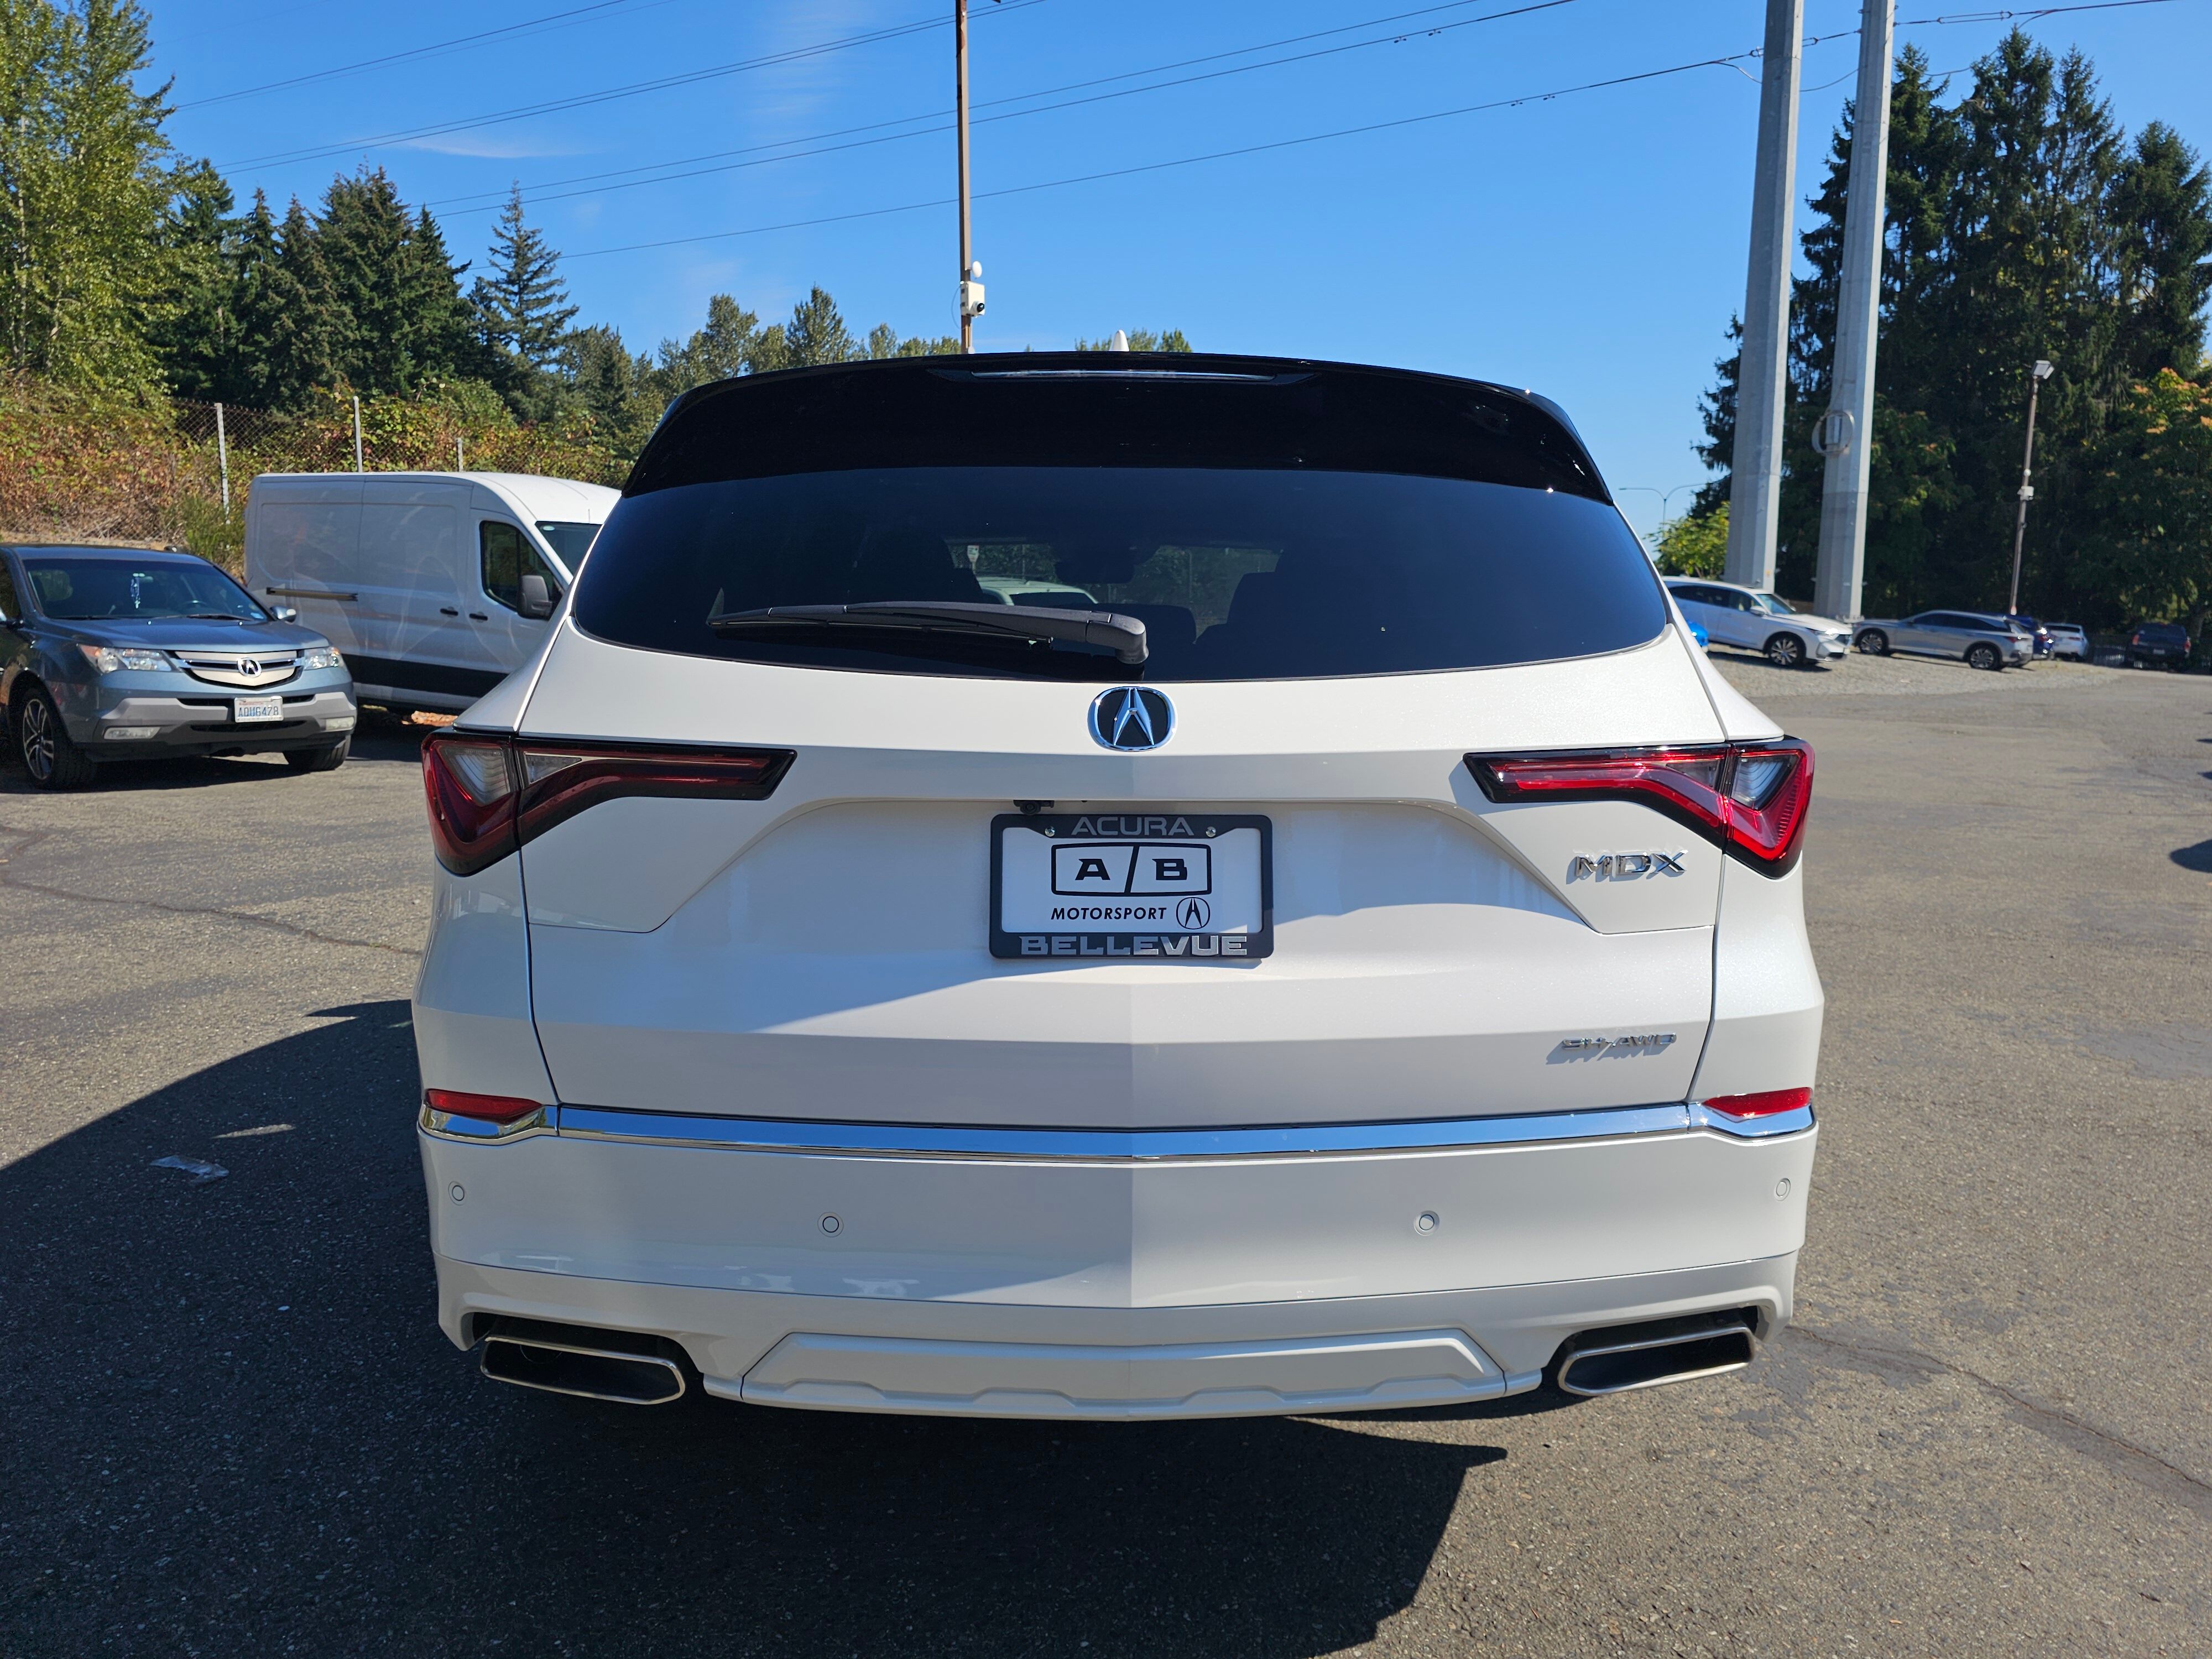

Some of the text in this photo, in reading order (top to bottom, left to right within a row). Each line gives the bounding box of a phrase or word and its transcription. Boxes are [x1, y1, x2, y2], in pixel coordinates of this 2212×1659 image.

[1071, 817, 1194, 836] ACURA
[1575, 852, 1688, 877] MDX
[1051, 907, 1167, 920] MOTORSPORT
[1019, 935, 1248, 956] BELLEVUE
[1562, 1032, 1677, 1050] SH-AWD
